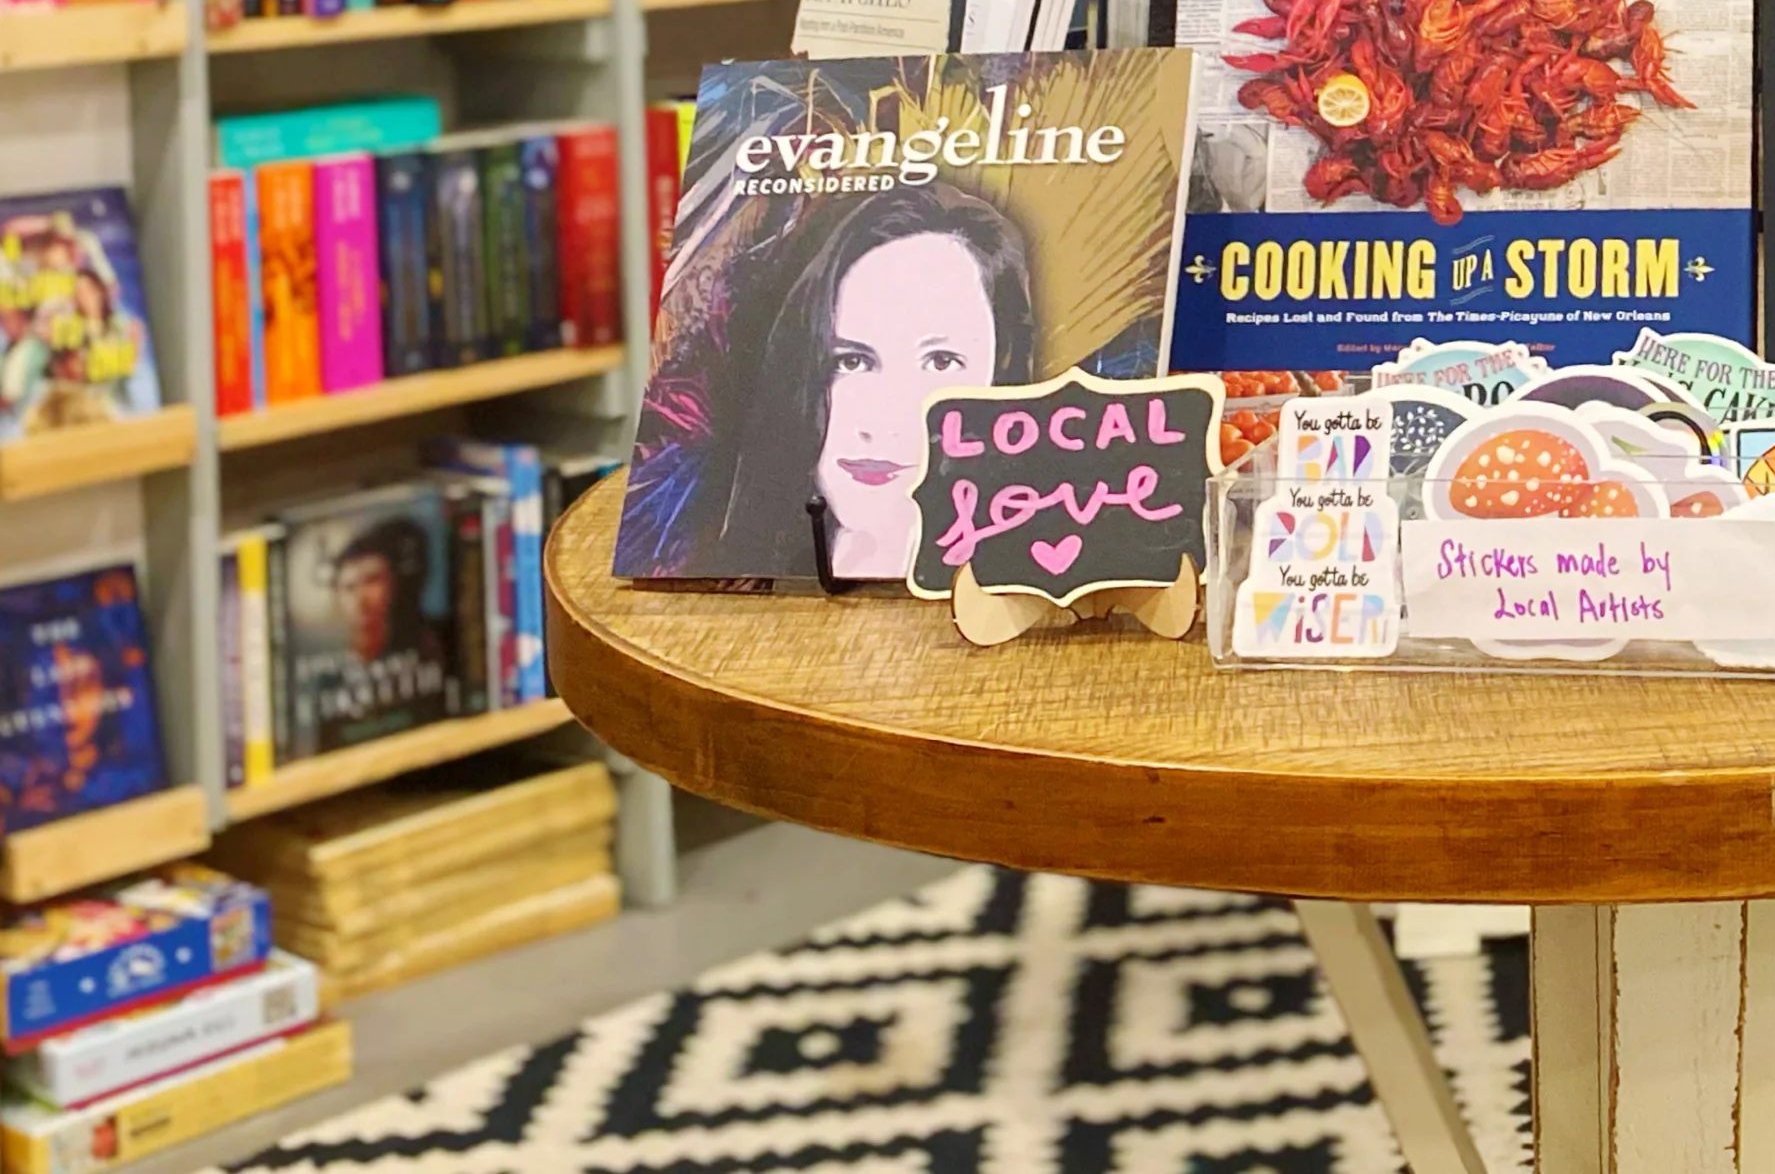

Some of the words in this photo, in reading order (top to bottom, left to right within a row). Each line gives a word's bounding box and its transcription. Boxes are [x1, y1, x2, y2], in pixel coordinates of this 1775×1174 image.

[735, 83, 1127, 187] evangeline
[732, 175, 895, 197] RECONSIDERED
[1219, 238, 1438, 302] COOKING
[1451, 254, 1476, 292] UP
[1480, 247, 1495, 283] A
[1505, 237, 1681, 300] STORM
[1226, 312, 1281, 327] Recipes
[1283, 311, 1314, 325] Lost
[1316, 311, 1343, 324] and
[1346, 311, 1388, 324] Found
[1391, 310, 1424, 324] from
[1427, 310, 1454, 324] The
[1456, 309, 1564, 327] Times-Picayune
[1566, 309, 1581, 323] of
[1583, 309, 1613, 323] New
[1616, 309, 1672, 323] Orleans
[1433, 362, 1472, 386] FOR
[1475, 349, 1517, 379] THE
[1637, 335, 1692, 375] HERE
[1693, 359, 1733, 385] FOR
[940, 397, 1187, 459] LOCAL
[1294, 410, 1321, 432] You
[1324, 410, 1363, 436] gotta
[1365, 410, 1382, 430] be
[1296, 434, 1374, 485] BAD
[1289, 487, 1314, 509] You
[1316, 488, 1354, 512] gotta
[1356, 487, 1374, 508] be
[1268, 510, 1384, 563] BOLD
[1279, 564, 1305, 587] You
[1307, 566, 1349, 591] gotta
[1351, 564, 1370, 587] be
[1437, 538, 1539, 580] Stickers
[1556, 542, 1620, 578] made
[1640, 541, 1672, 592] by
[1493, 587, 1560, 622] Local
[1578, 588, 1665, 624] Artists
